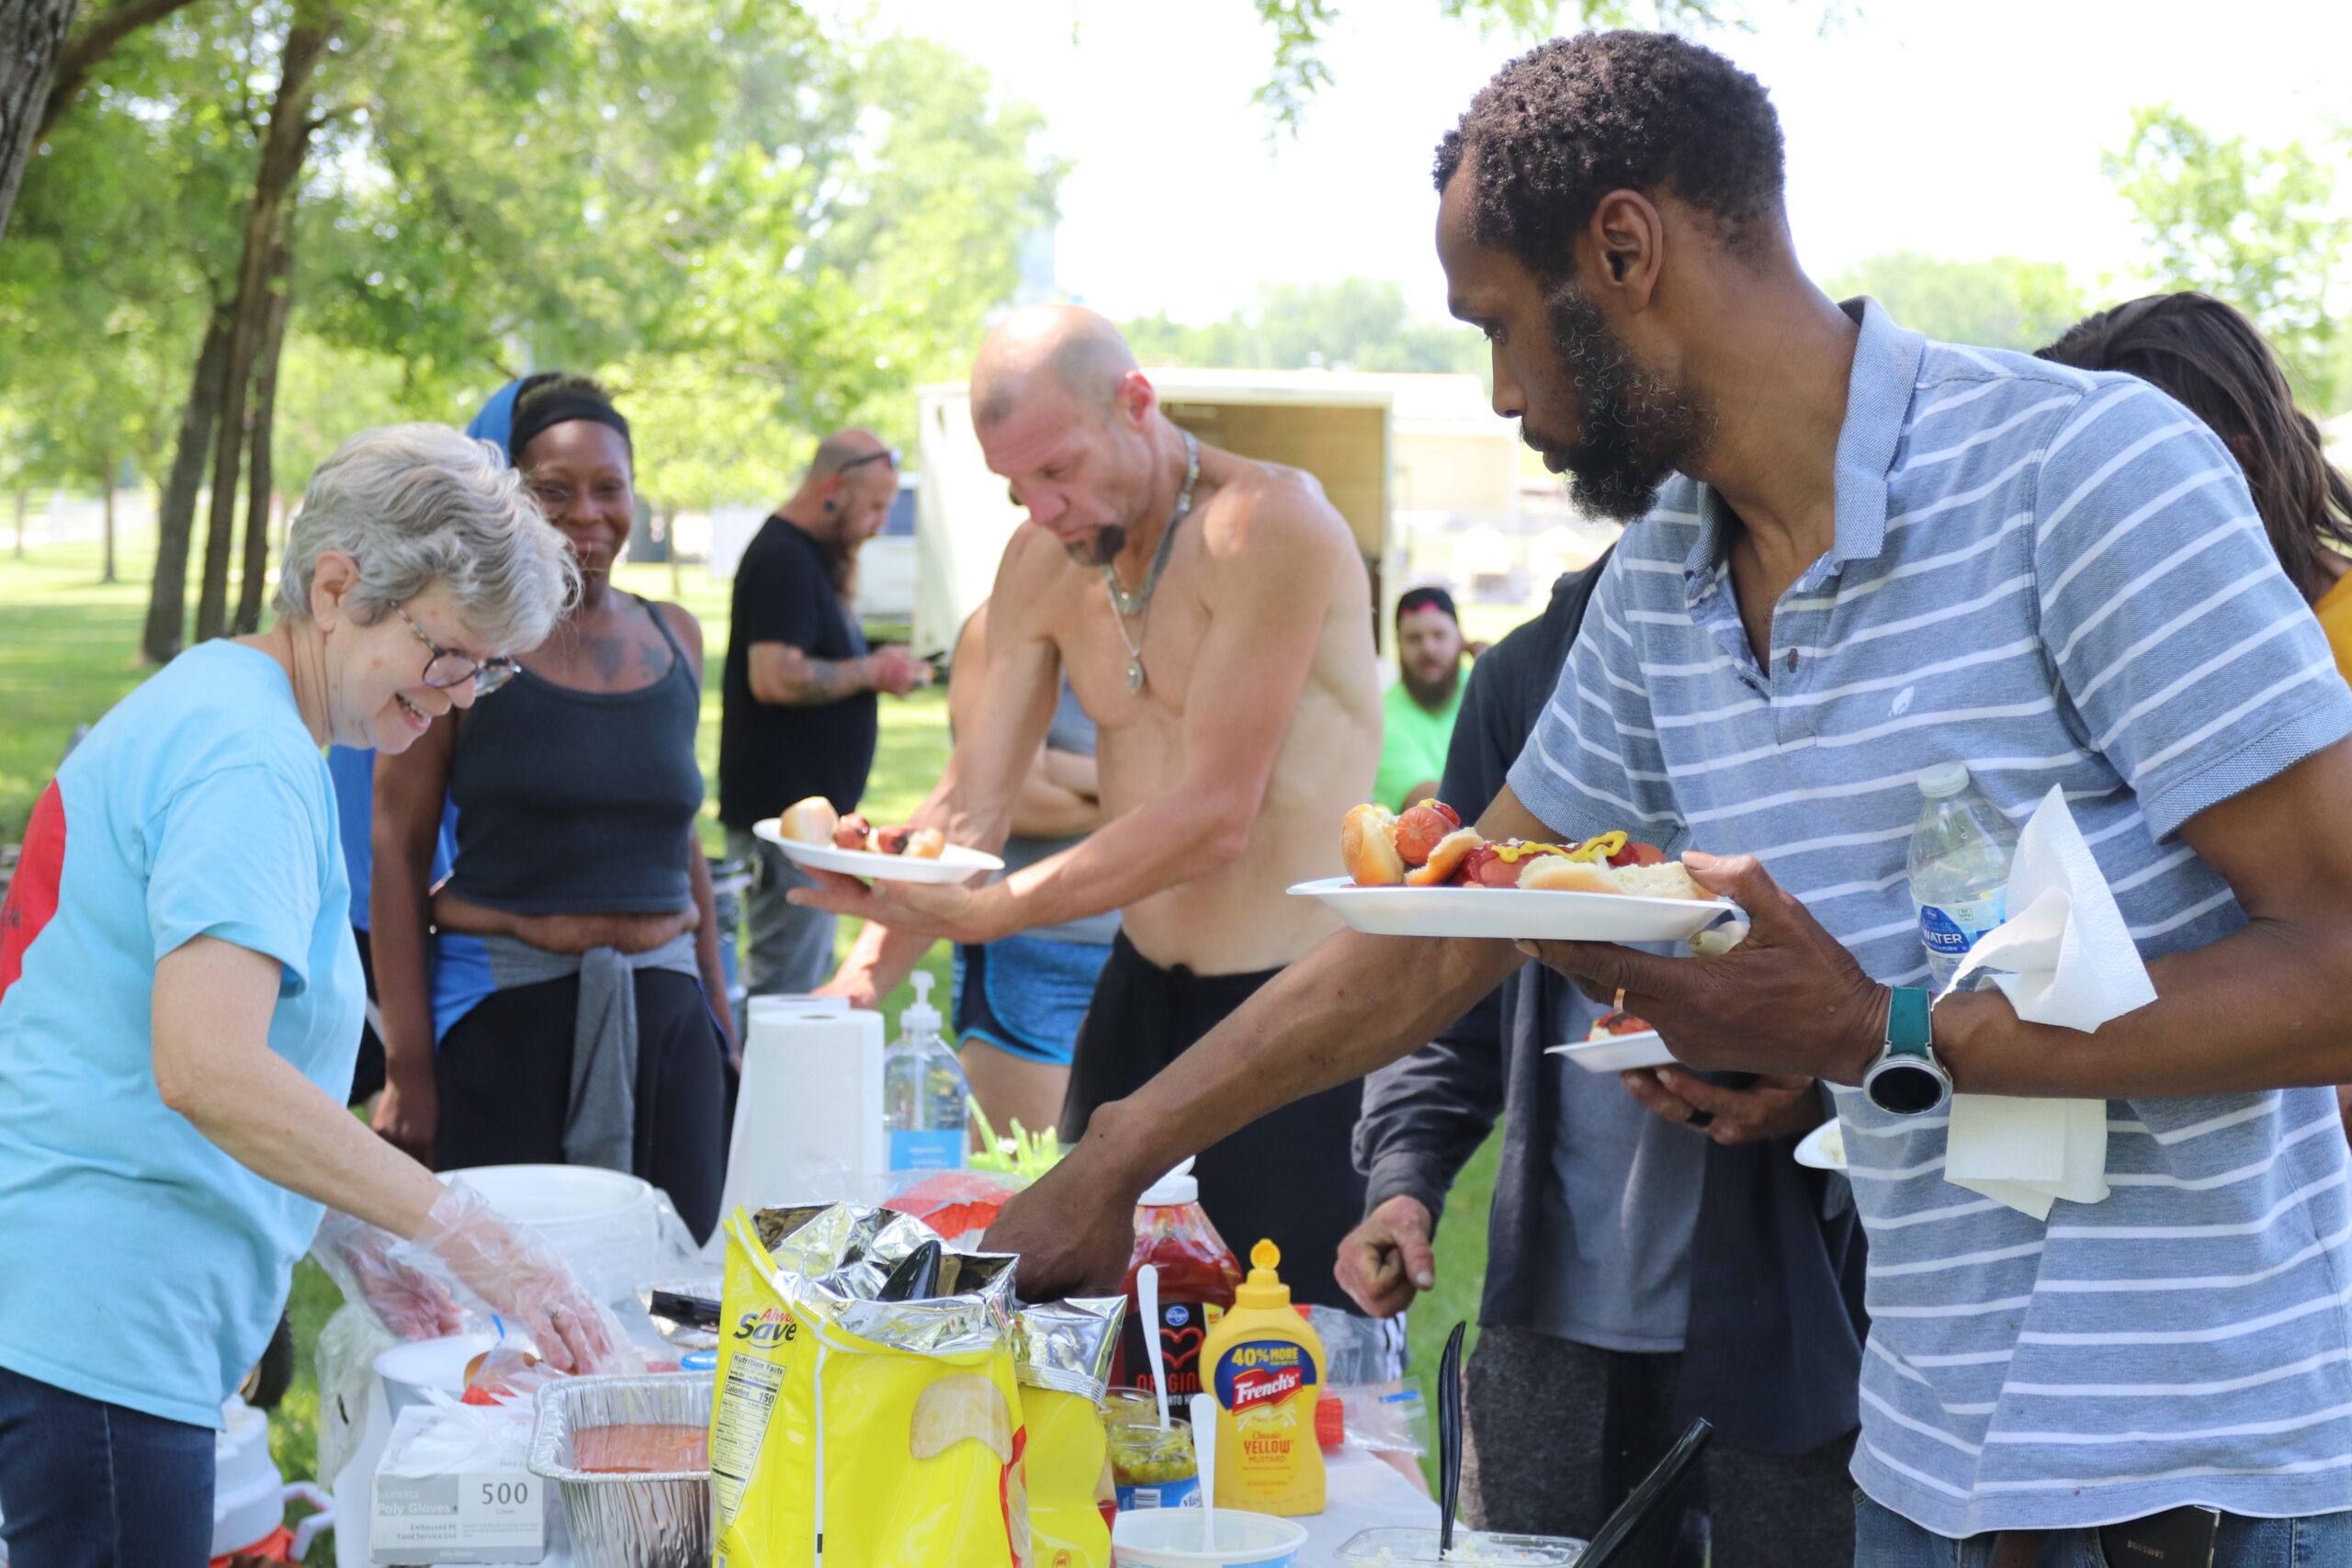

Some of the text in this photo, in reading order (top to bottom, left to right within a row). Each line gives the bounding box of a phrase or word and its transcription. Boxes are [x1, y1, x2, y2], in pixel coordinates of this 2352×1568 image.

[1921, 925, 1964, 944] WATER
[733, 1313, 797, 1341] Save
[733, 1354, 764, 1370] Nutrition
[765, 1363, 784, 1375] Facts
[1232, 1348, 1299, 1366] 40% MORE
[725, 1383, 751, 1397] Calories
[759, 1391, 775, 1404] 150
[1235, 1374, 1296, 1404] French's
[1243, 1439, 1291, 1455] YELLOW
[481, 1482, 528, 1505] 500
[378, 1502, 403, 1517] Poly
[411, 1523, 447, 1531] Embossed
